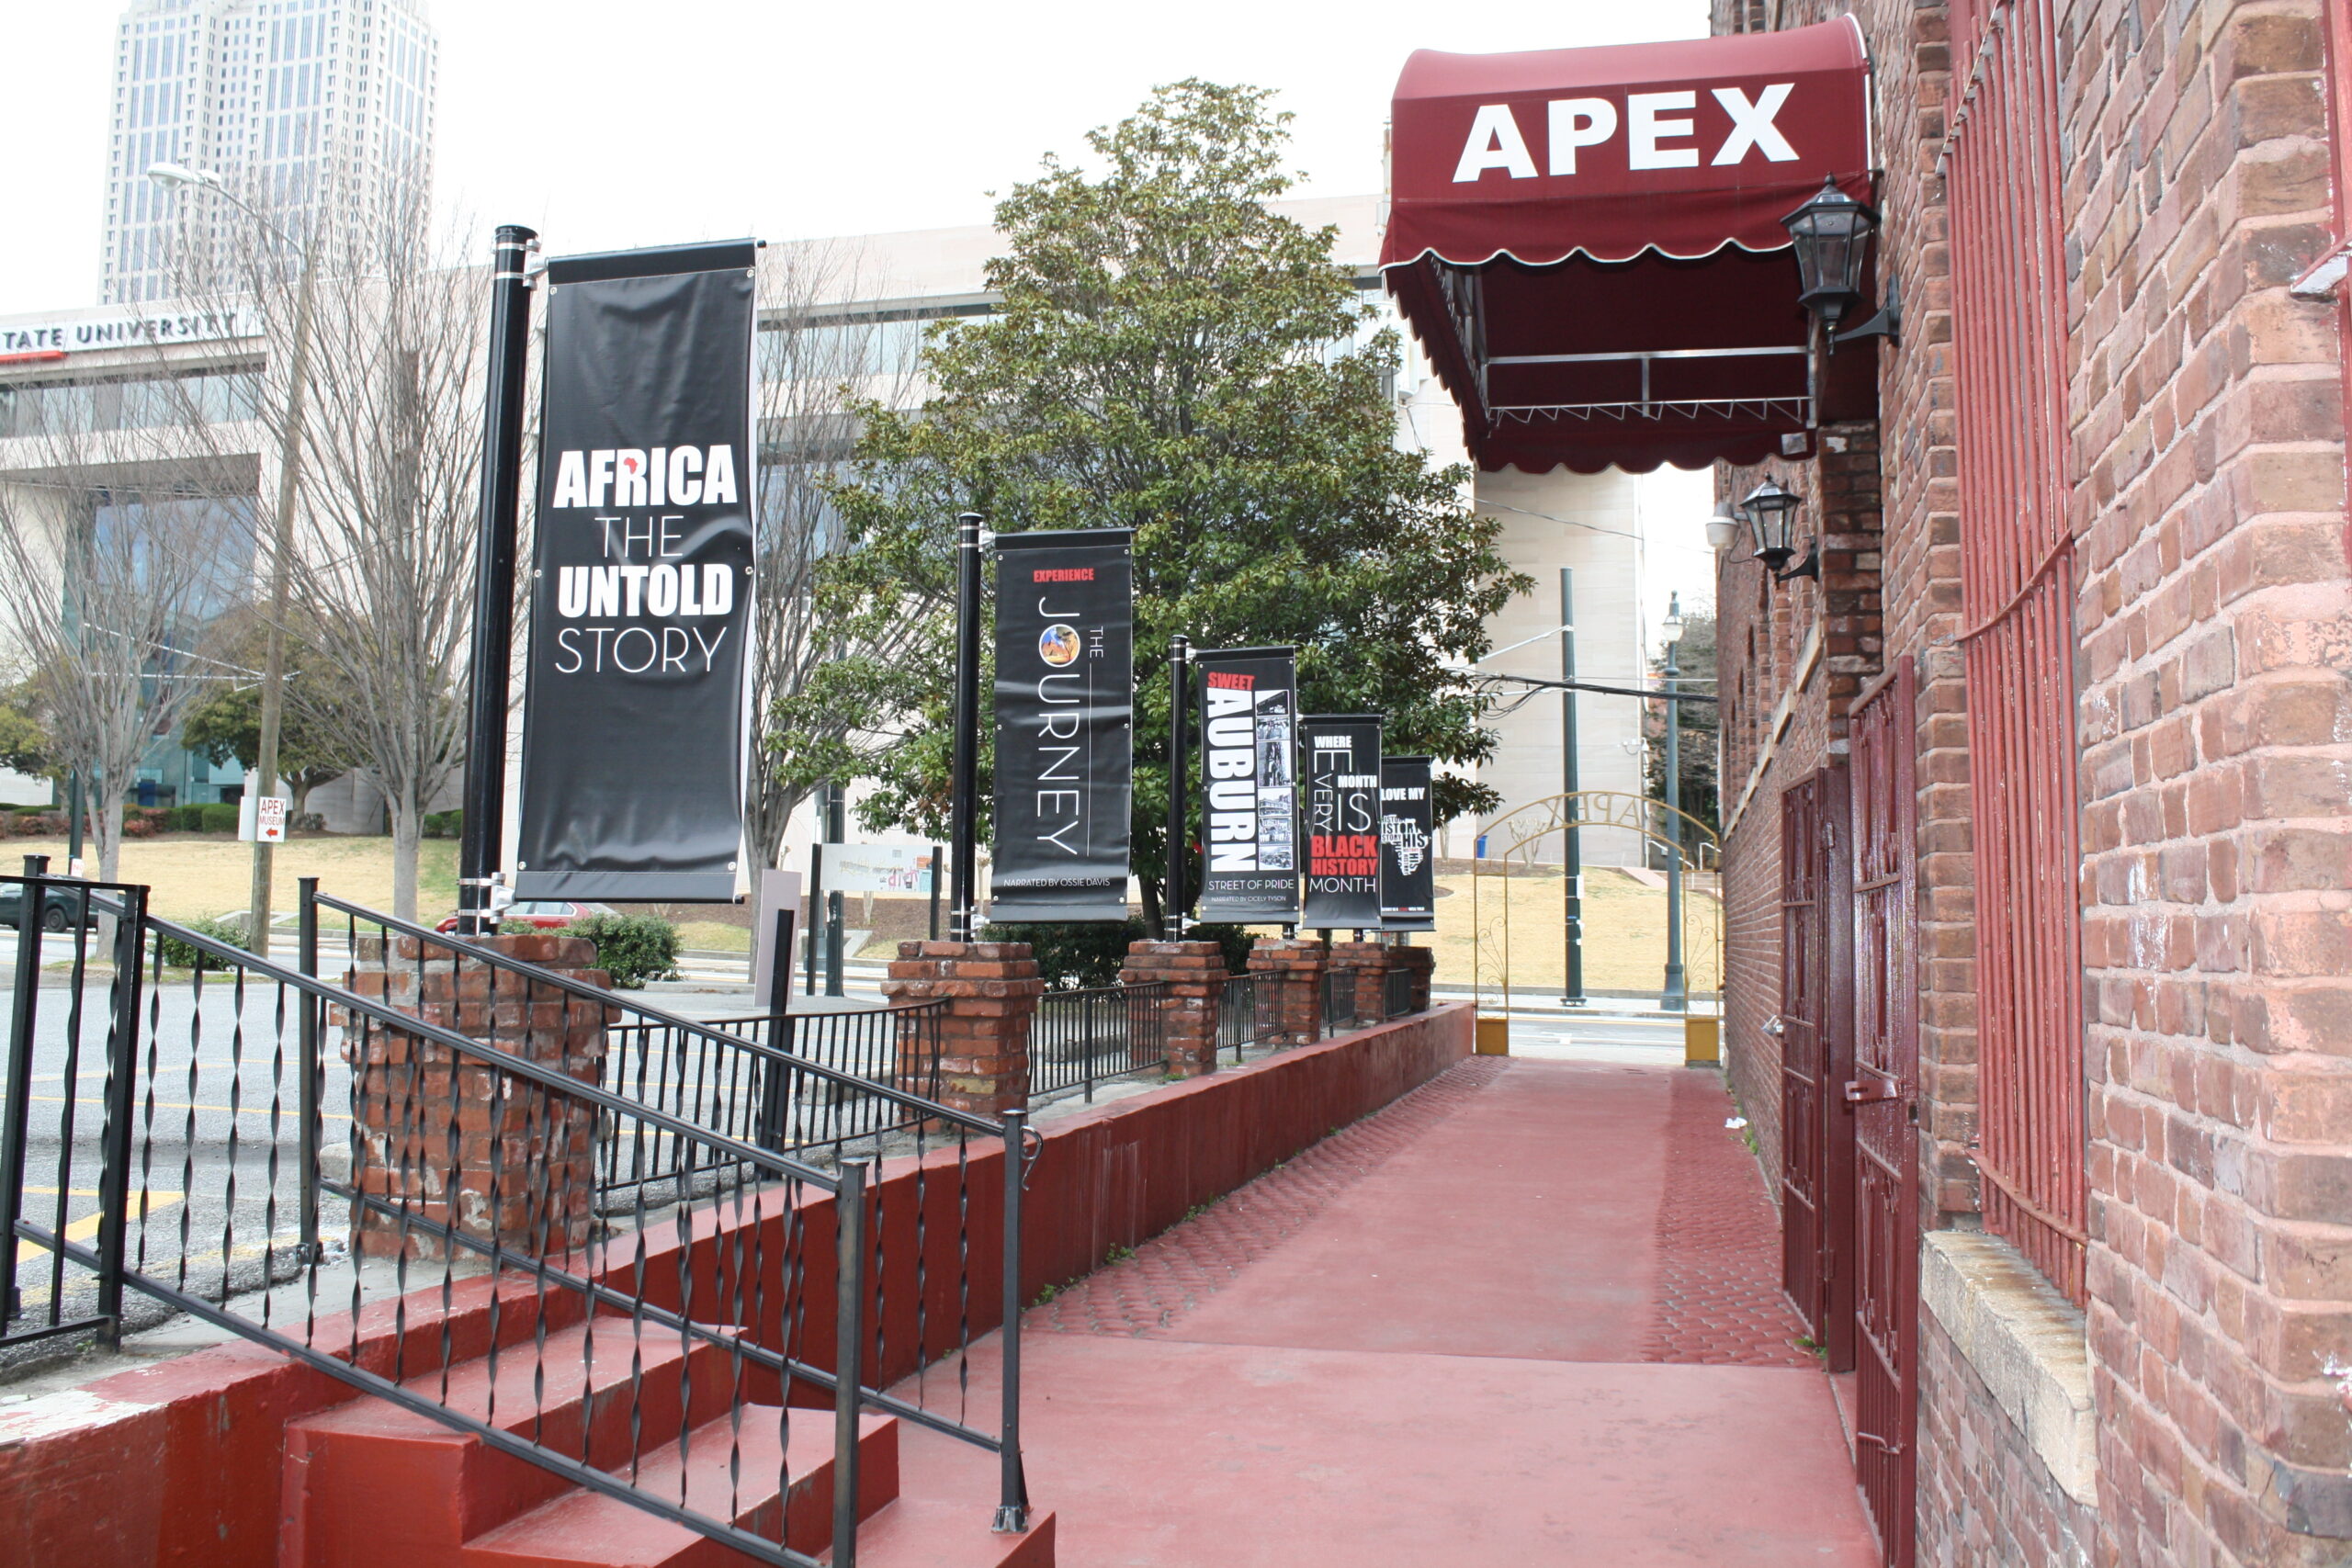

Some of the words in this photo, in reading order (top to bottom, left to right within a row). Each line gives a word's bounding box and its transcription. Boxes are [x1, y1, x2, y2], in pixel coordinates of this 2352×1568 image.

[1453, 83, 1800, 183] APEX
[3, 327, 63, 350] TATE
[76, 311, 236, 344] UNIVERSITY
[552, 445, 738, 508] AFRICA
[594, 515, 684, 558] THE
[1034, 568, 1094, 582] EXPERIENCE
[558, 563, 733, 618] UNTOLD
[555, 626, 727, 673] STORY
[1090, 626, 1103, 659] THE
[1207, 671, 1255, 690] SWEET
[1037, 596, 1080, 854] JOURNEY
[1314, 736, 1352, 749] WHERE
[1206, 687, 1256, 873] AUBURN
[1314, 750, 1352, 831] EVERY
[1338, 775, 1377, 788] MONTH
[1381, 788, 1407, 801] LOVE
[1408, 787, 1425, 800] MY
[261, 799, 285, 815] APEX
[1338, 793, 1371, 832] IS
[259, 816, 285, 826] MUSEUM
[1310, 835, 1378, 858] BLACK
[1403, 834, 1425, 847] HIS
[1310, 858, 1378, 876] HISTORY
[1003, 878, 1047, 887] NARRATED
[1048, 878, 1059, 886] BY
[1060, 877, 1084, 886] OSSIE
[1086, 877, 1111, 886] DAVIS
[1208, 880, 1245, 890] STREET
[1247, 879, 1262, 890] OF
[1264, 879, 1295, 889] PRIDE
[1308, 877, 1376, 893] MONTH
